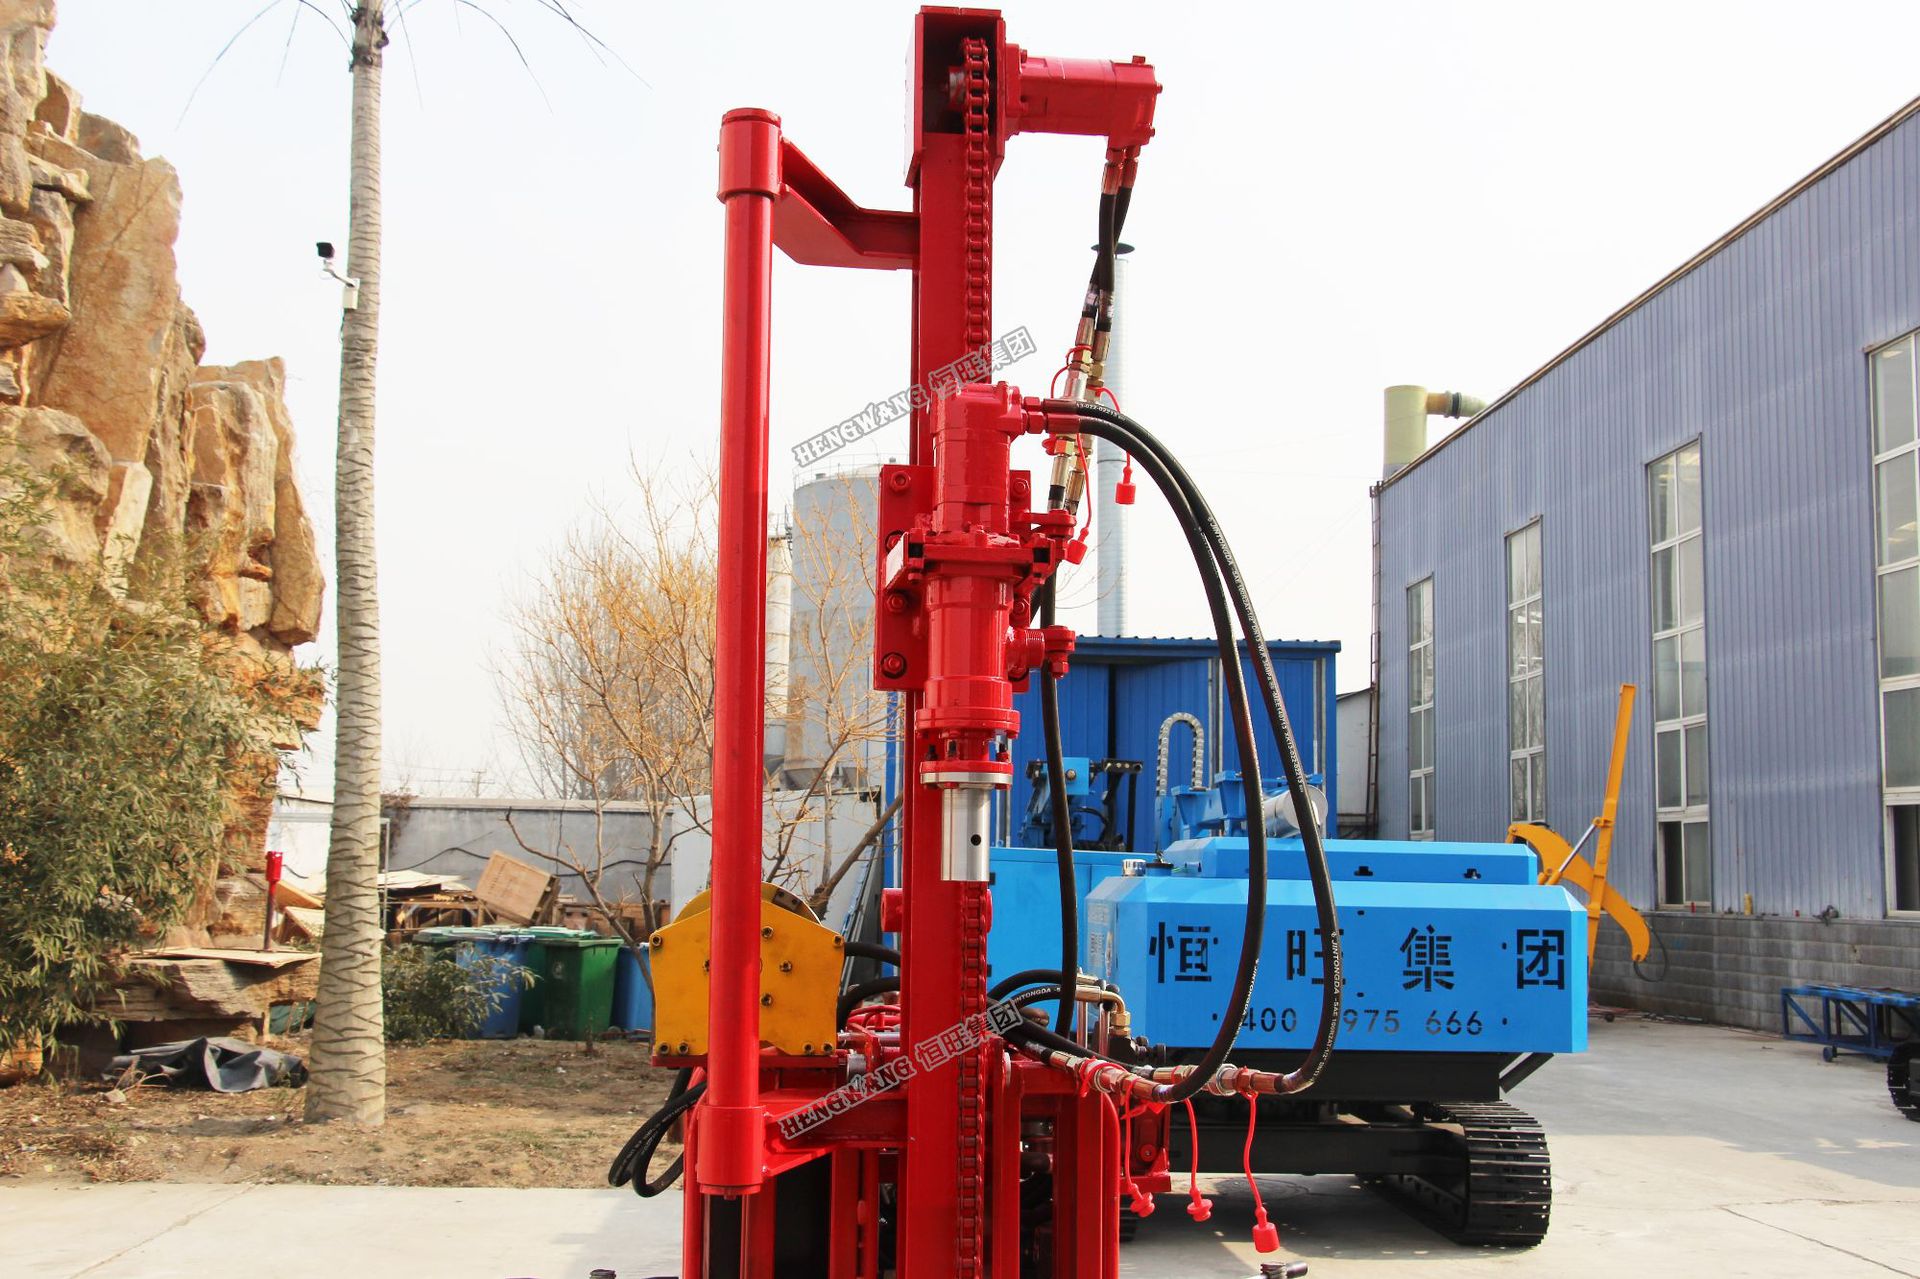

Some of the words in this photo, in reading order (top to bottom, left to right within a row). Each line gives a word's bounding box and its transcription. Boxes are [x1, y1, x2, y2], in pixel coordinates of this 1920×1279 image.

[1330, 938, 1341, 994] JINTONGDA
[1242, 1008, 1297, 1032] 400
[1343, 1009, 1400, 1034] 975
[1425, 1010, 1483, 1035] 666
